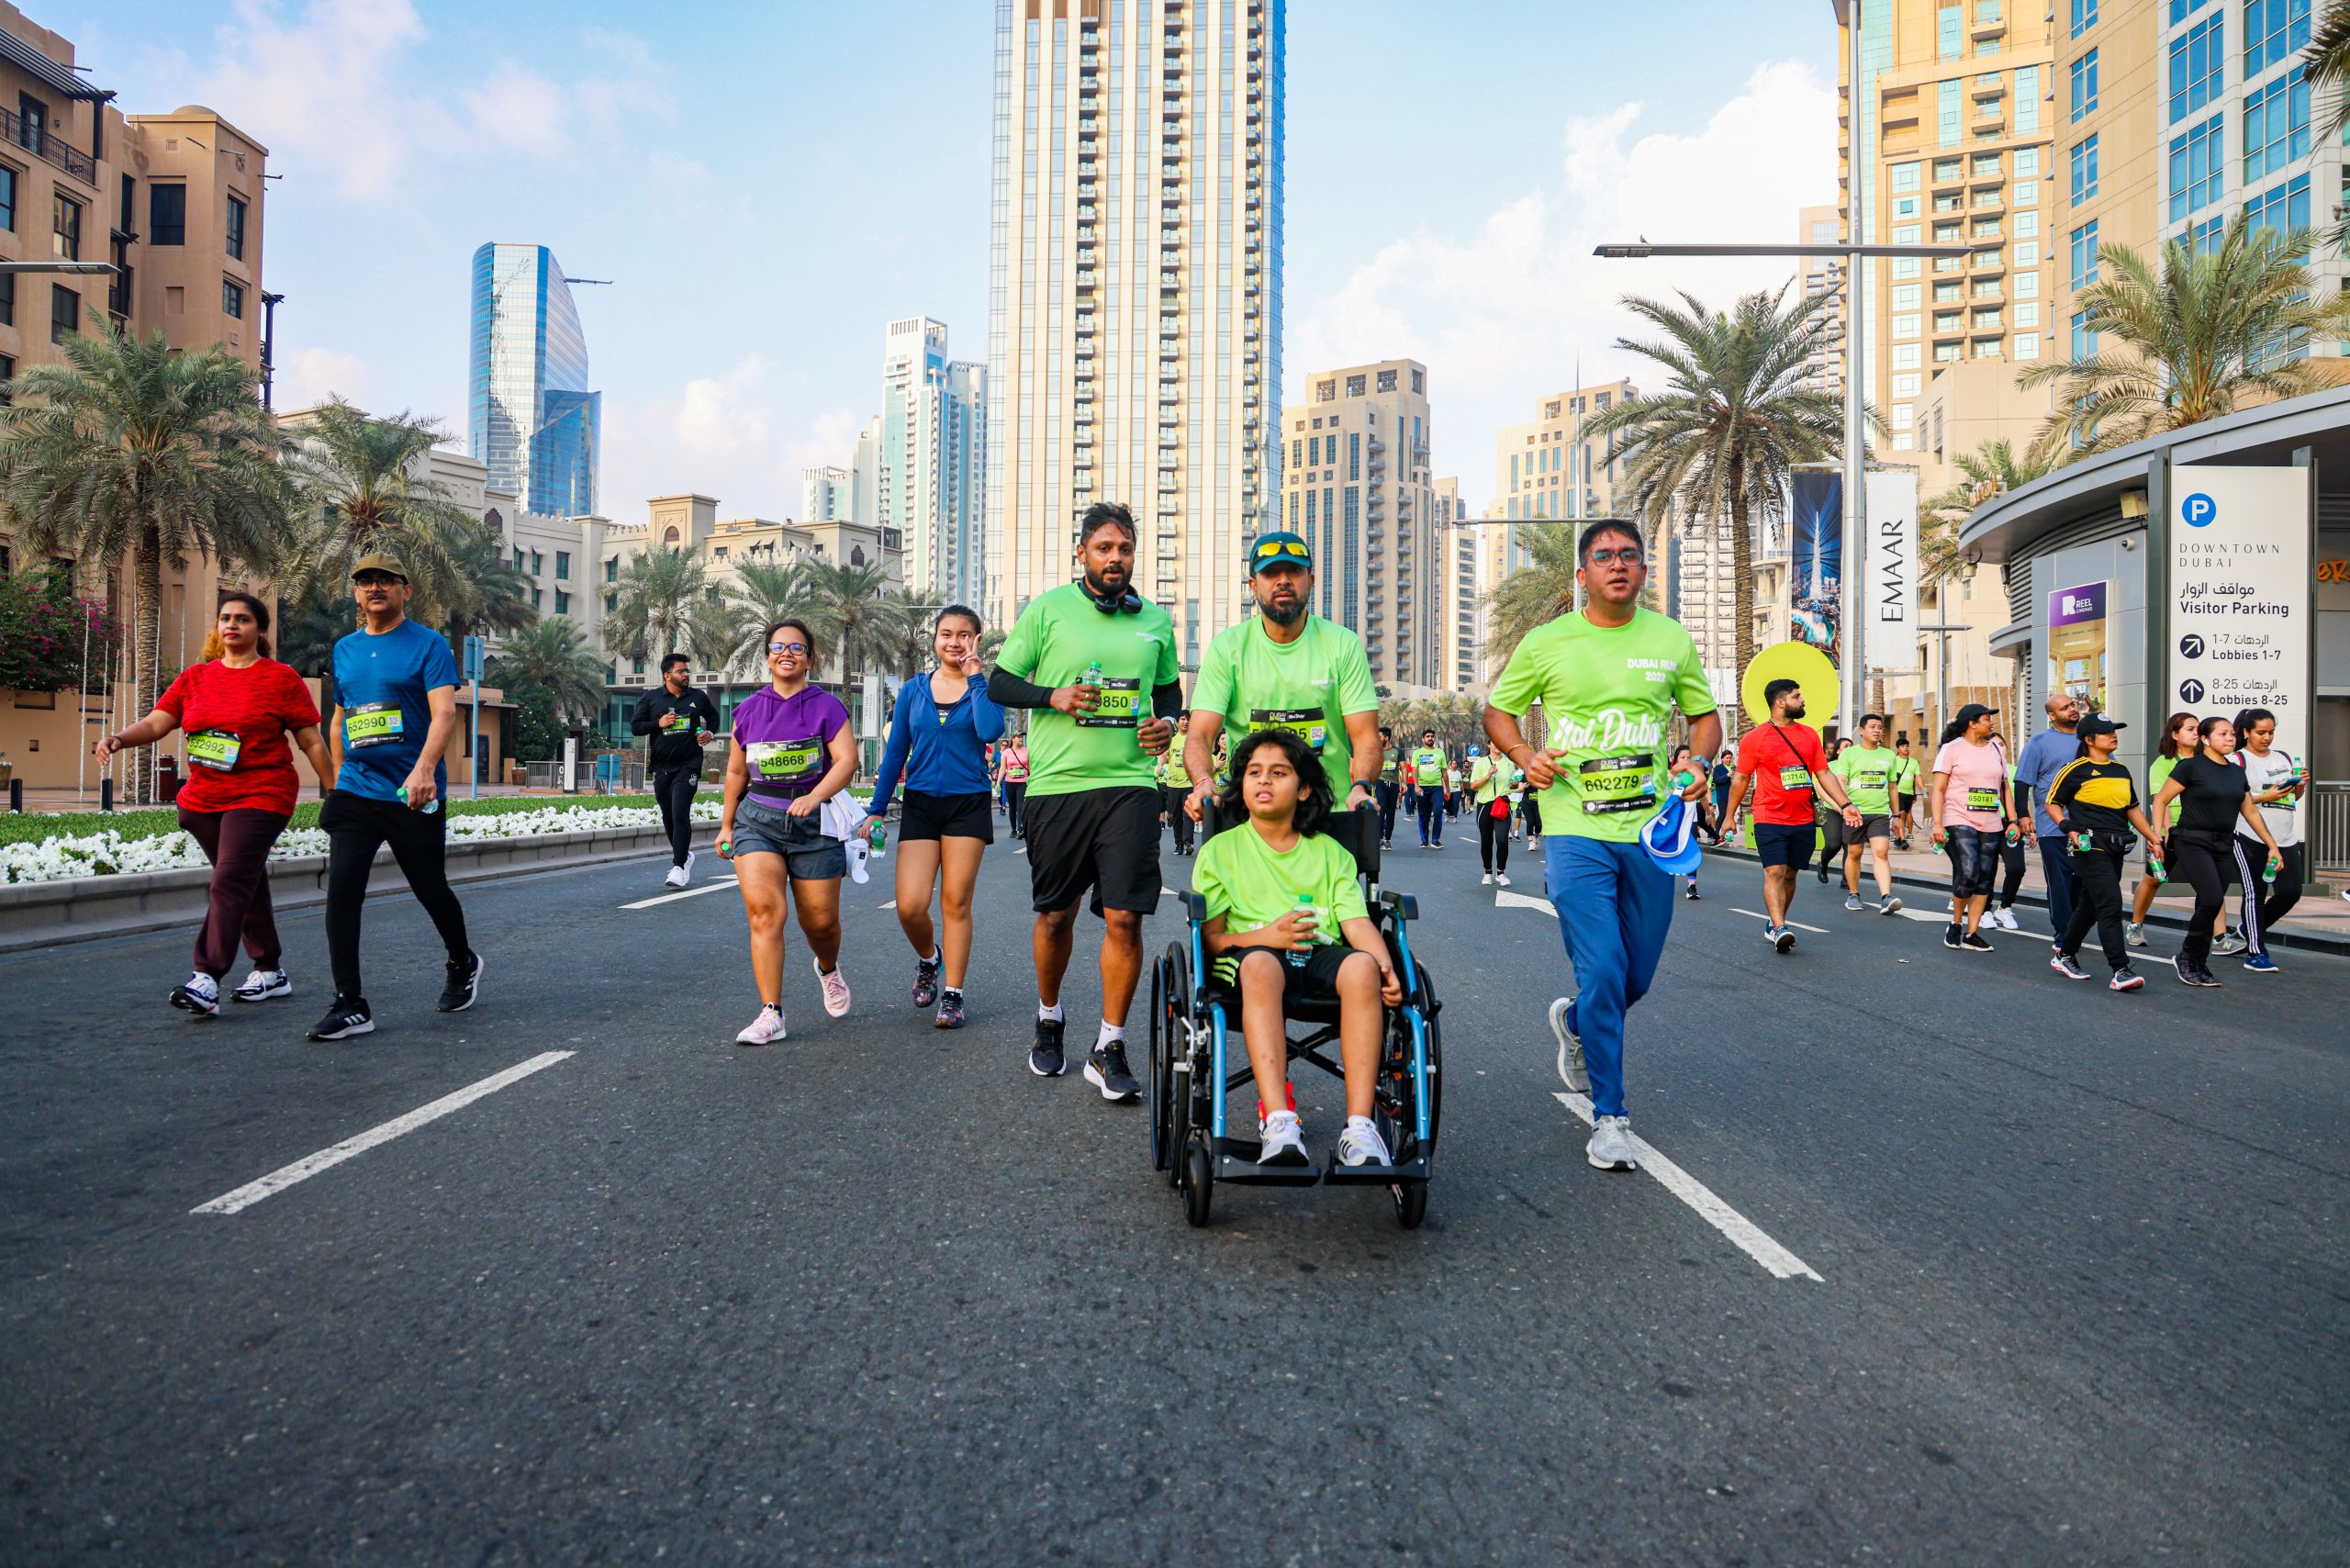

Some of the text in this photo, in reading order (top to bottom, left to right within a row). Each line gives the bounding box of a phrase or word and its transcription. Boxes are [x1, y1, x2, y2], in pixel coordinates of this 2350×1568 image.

[2191, 499, 2210, 521] P
[2179, 543, 2280, 554] DOWNTOWN
[2179, 557, 2232, 567] DUBAI
[1881, 519, 1903, 622] EMAAR
[2179, 582, 2255, 599] مواقف الزوار
[2076, 598, 2093, 608] REEL
[2180, 601, 2289, 618] Visitor Parking
[2212, 633, 2269, 648] الردهات 1-7
[2212, 649, 2281, 660] Lobbies 1-7
[1628, 658, 1678, 671] DUBAI RUN
[1645, 671, 1666, 682] 2022
[2212, 678, 2277, 693] الردهات 8-25
[2211, 694, 2288, 705] Lobbies 8-25
[348, 716, 386, 733] 652990
[189, 738, 226, 753] 652992
[760, 756, 804, 767] 548668
[1584, 775, 1639, 792] 602279
[1782, 773, 1807, 782] 637147
[1968, 795, 1993, 803] 650181
